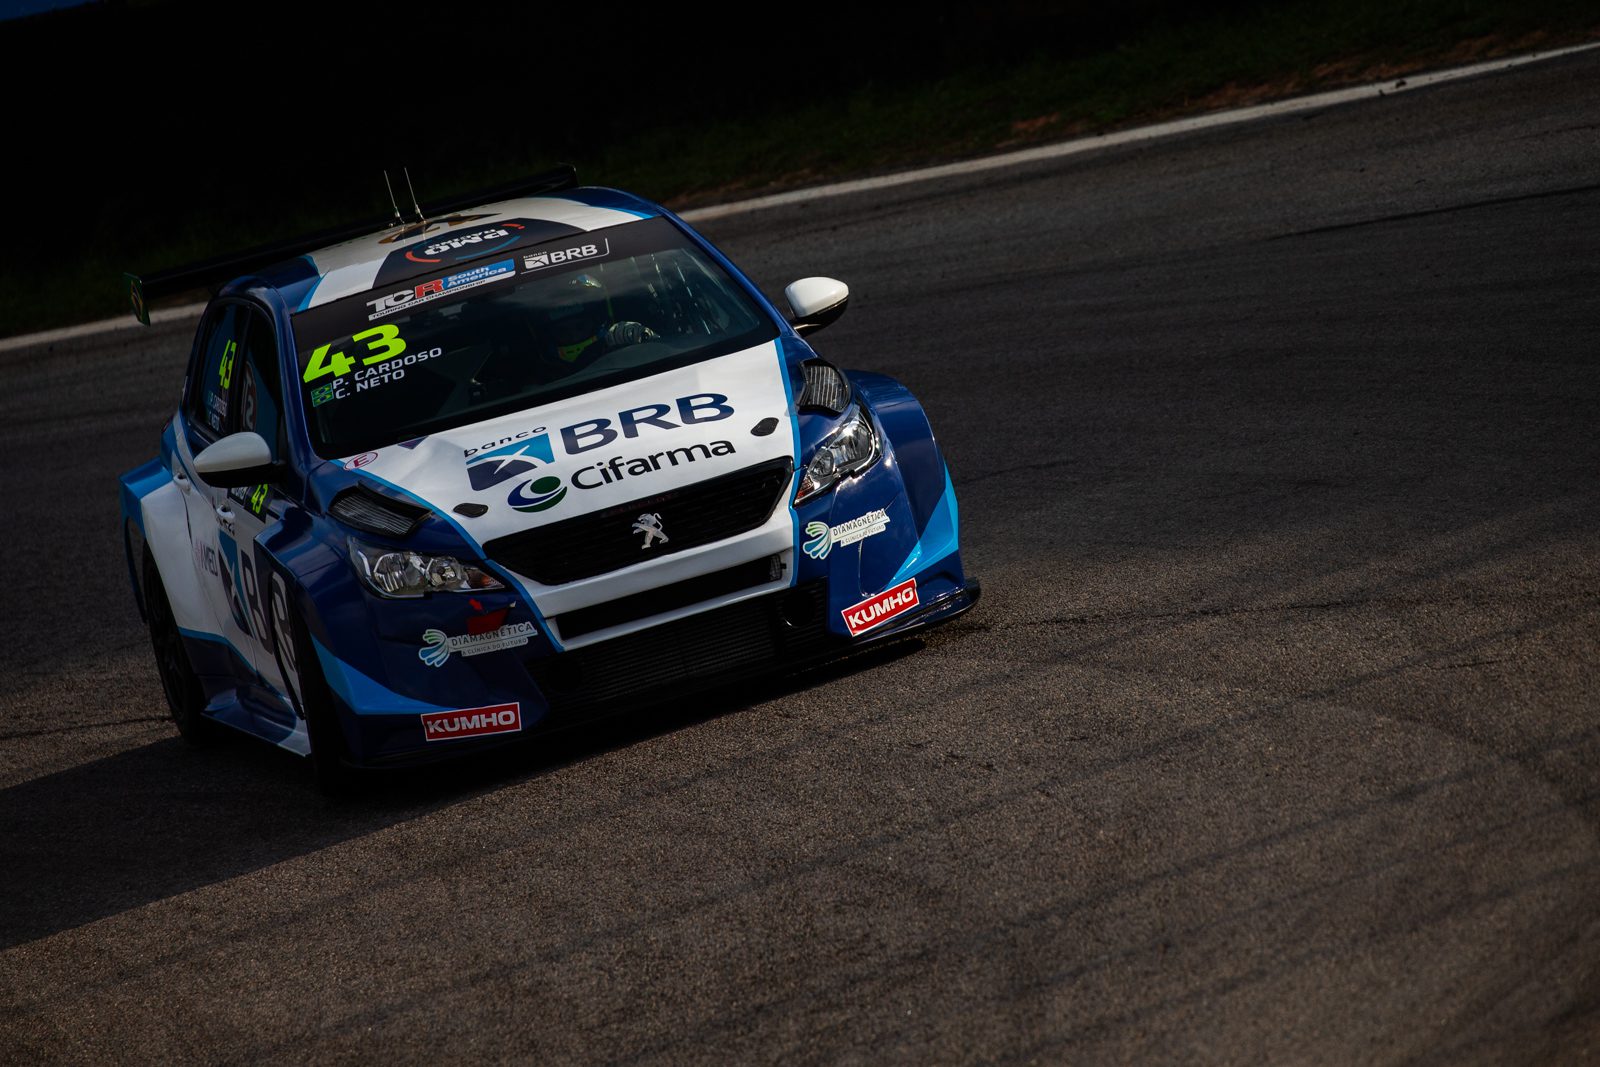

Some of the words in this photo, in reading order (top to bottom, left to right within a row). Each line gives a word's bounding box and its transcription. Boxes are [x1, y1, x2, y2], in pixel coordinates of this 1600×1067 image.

[549, 244, 599, 264] BRB
[446, 266, 507, 289] America
[447, 265, 490, 281] South
[365, 278, 444, 313] TCR
[372, 303, 407, 319] TOURING
[408, 298, 425, 307] CAR
[218, 338, 238, 390] 43
[302, 323, 408, 384] 43
[332, 376, 350, 390] P.
[354, 346, 443, 382] CARDOSO
[335, 387, 351, 400] C.
[355, 368, 406, 393] NETO
[559, 392, 736, 456] BRB
[463, 425, 547, 458] banco
[570, 439, 737, 490] Cifarma
[847, 586, 915, 629] KUMHO
[426, 709, 516, 734] KUMHO
